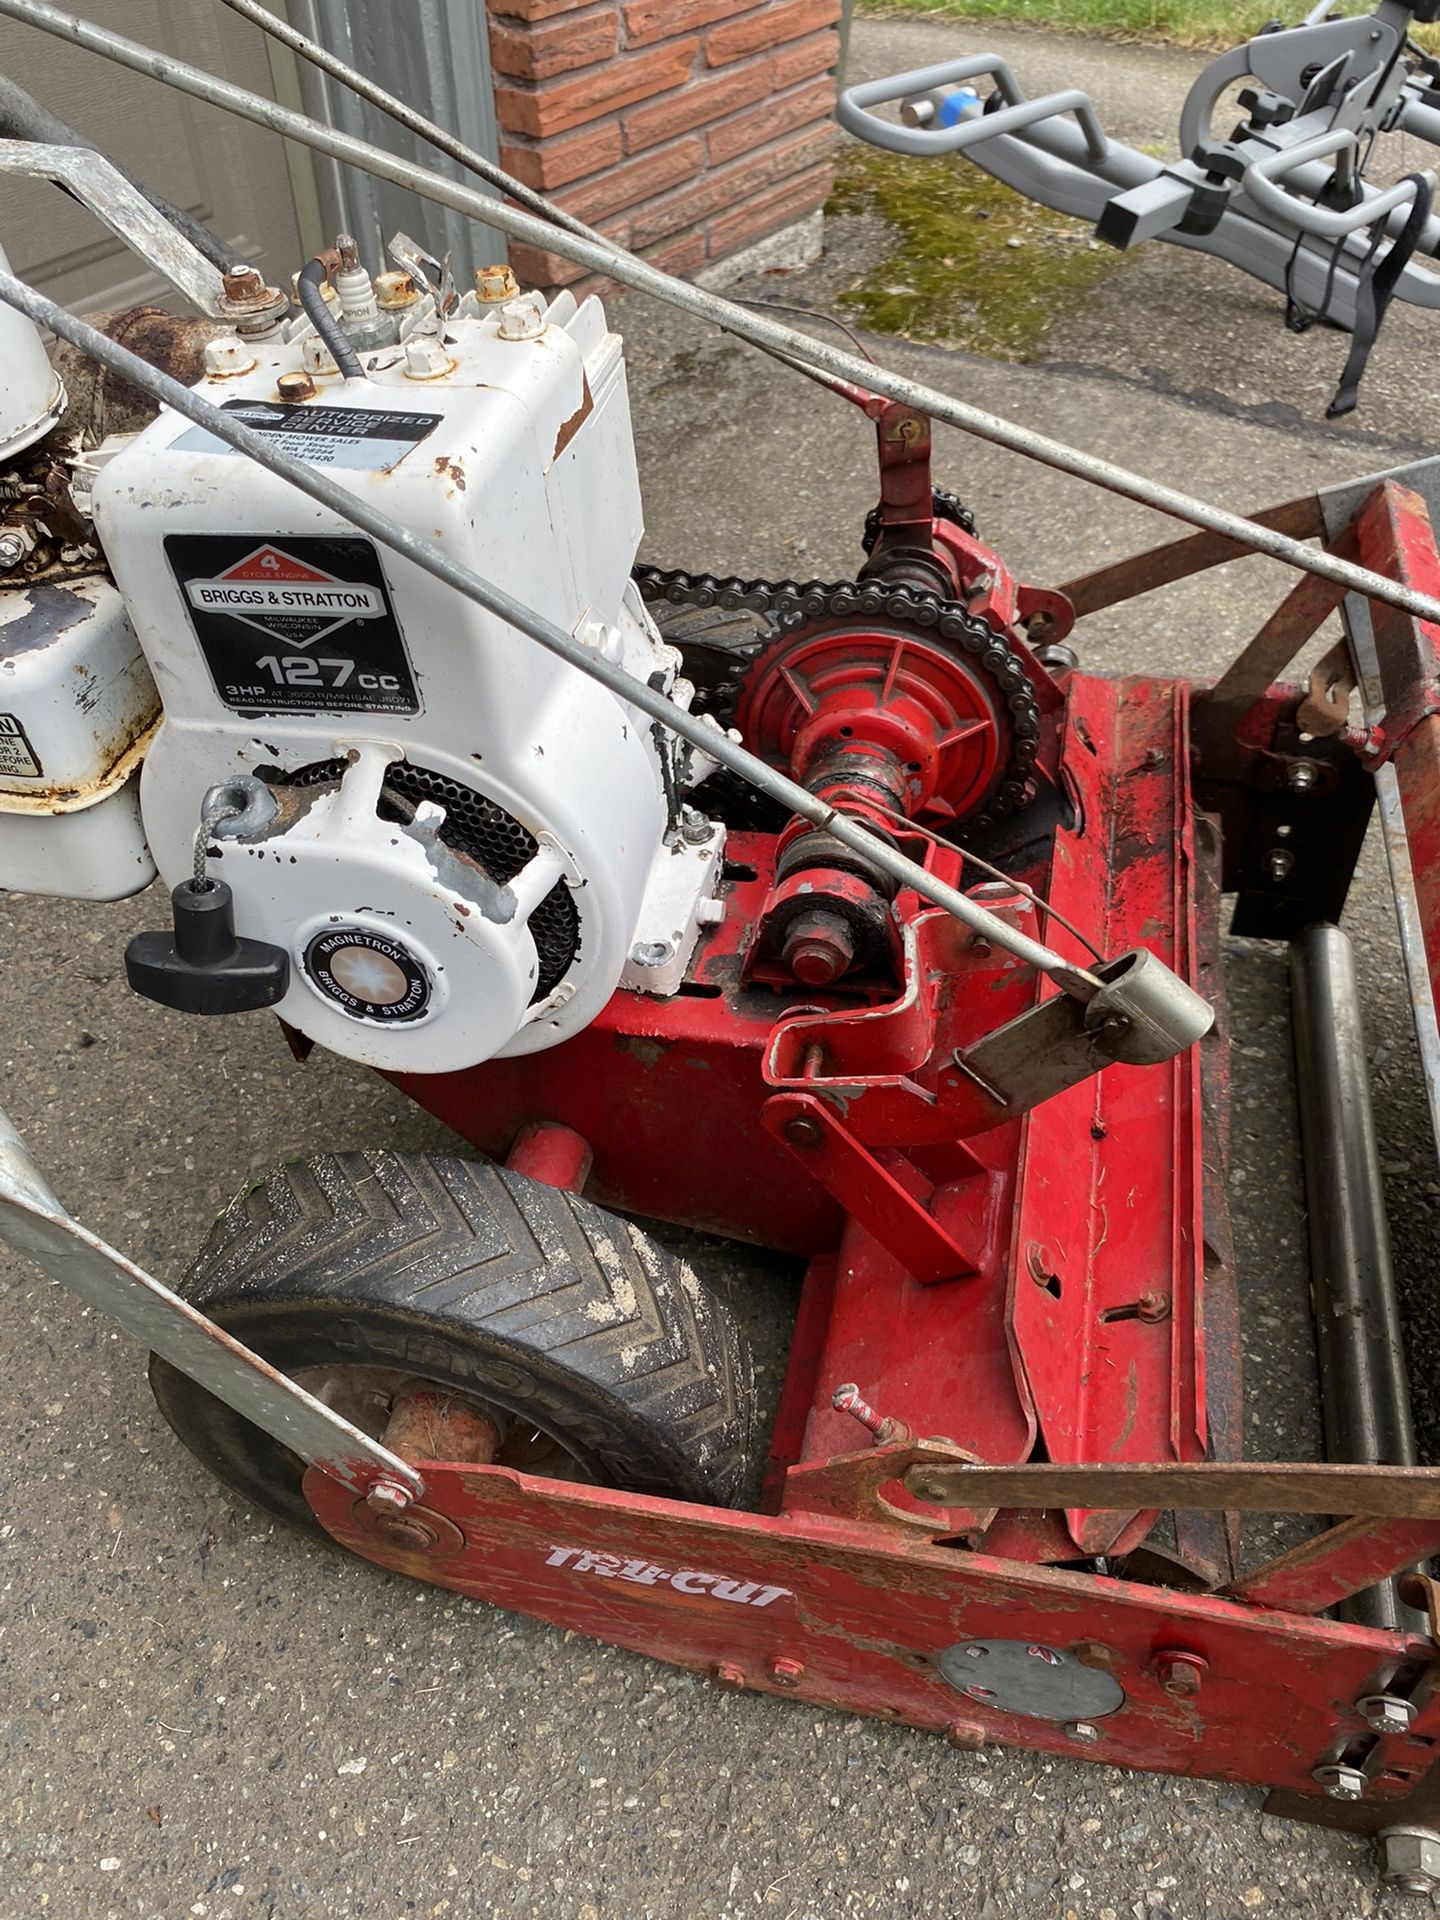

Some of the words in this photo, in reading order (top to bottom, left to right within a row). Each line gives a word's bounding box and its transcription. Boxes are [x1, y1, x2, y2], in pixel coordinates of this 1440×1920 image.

[287, 415, 382, 428] SERVICE
[295, 409, 433, 425] AUTHORIZED
[280, 422, 369, 434] CENTER
[286, 434, 328, 443] MOWER
[260, 554, 280, 571] 4
[275, 571, 310, 579] ENGINE
[200, 589, 265, 605] BRIGGS
[268, 591, 280, 605] &
[282, 591, 370, 608] STRATTON
[264, 615, 319, 624] MILWAUKEE
[267, 622, 322, 631] WISCONSIN
[255, 655, 356, 688] 127
[256, 697, 324, 706] INSTRUCTIONS
[326, 701, 363, 709] BEFORE
[365, 703, 411, 712] STARTING
[319, 935, 401, 960] MAGNETRON
[318, 970, 358, 1007] BRIGGS
[366, 1004, 375, 1014] &
[381, 979, 422, 1016] STRATTON
